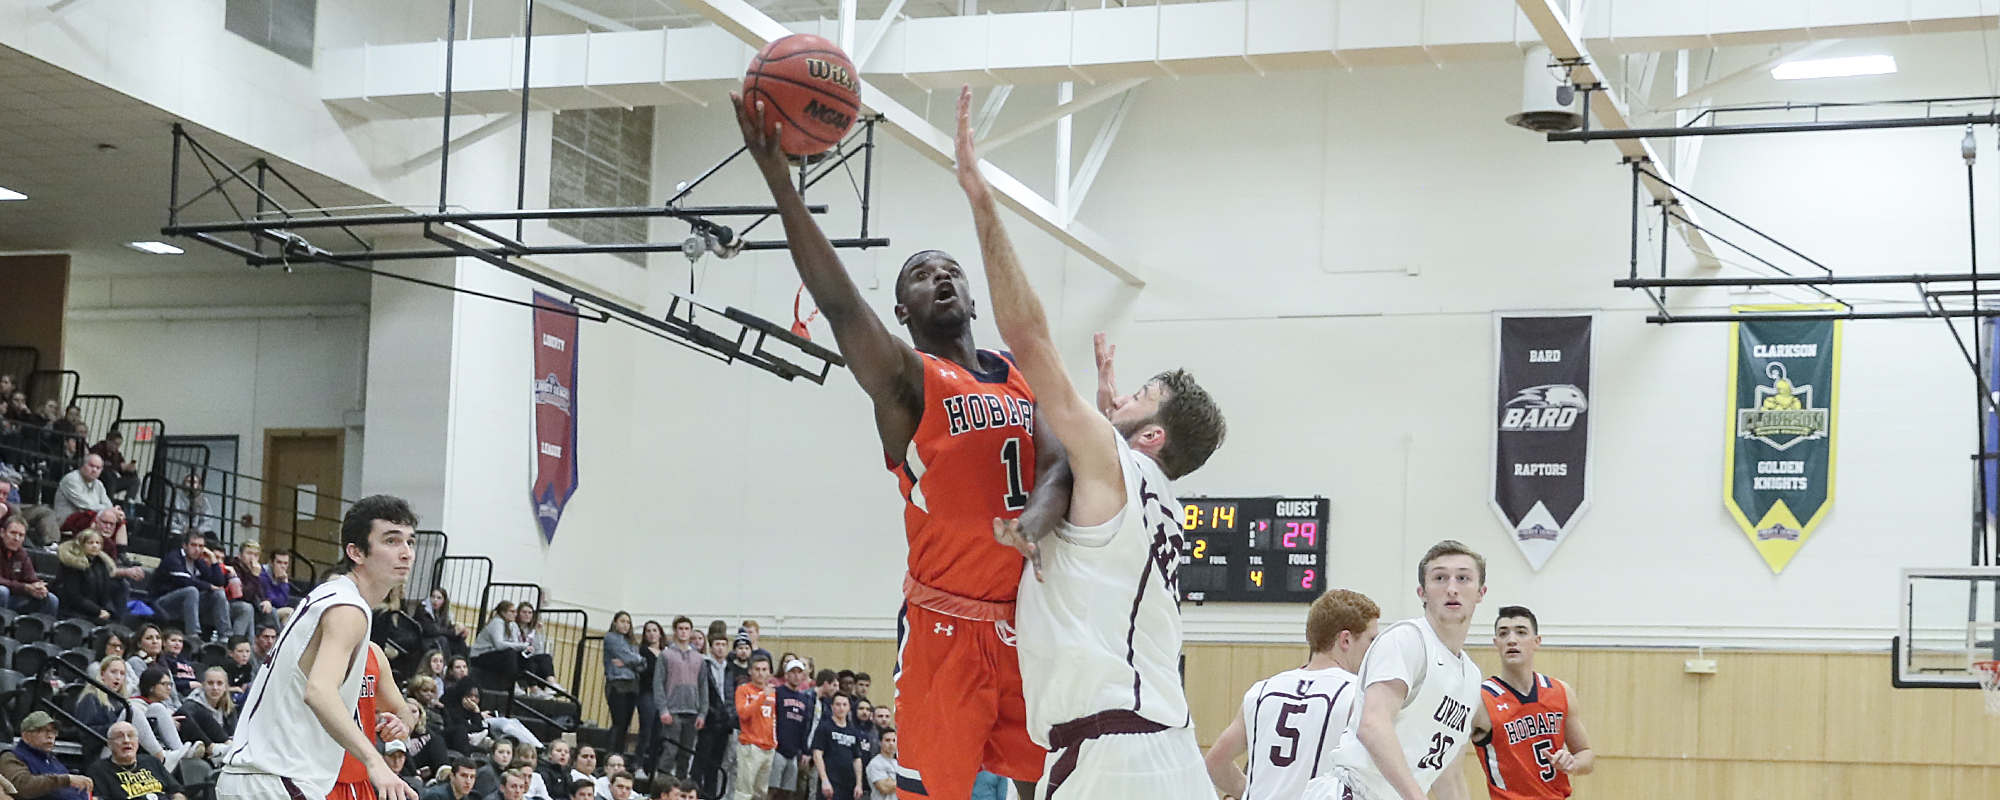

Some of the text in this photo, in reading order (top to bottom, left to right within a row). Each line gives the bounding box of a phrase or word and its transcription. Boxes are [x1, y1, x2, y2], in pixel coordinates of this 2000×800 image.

[806, 59, 859, 94] Wils
[1529, 349, 1561, 363] BARD
[1753, 343, 1818, 358] CLARKSON
[943, 394, 1034, 435] HOBAR
[1501, 407, 1578, 430] BARD
[1742, 411, 1825, 431] CLARKSON
[540, 441, 562, 458] LEAGUE
[1000, 437, 1029, 511] 1
[1514, 463, 1567, 476] RAPTORS
[1758, 461, 1804, 474] GOLDEN
[1754, 477, 1807, 490] KNIGHTS
[1183, 504, 1235, 530] 8:14
[1276, 501, 1318, 517] GUEST
[1283, 522, 1317, 548] 29
[1193, 540, 1207, 559] 2
[1210, 555, 1228, 565] FOUL
[1250, 556, 1263, 565] TOL
[1288, 554, 1317, 566] FOULS
[1250, 570, 1263, 587] 4
[1301, 569, 1316, 589] 2
[1433, 695, 1471, 733] UNION
[1269, 702, 1308, 767] 5
[1503, 711, 1564, 746] HOBART
[1418, 732, 1455, 770] 20
[1532, 739, 1557, 783] 5
